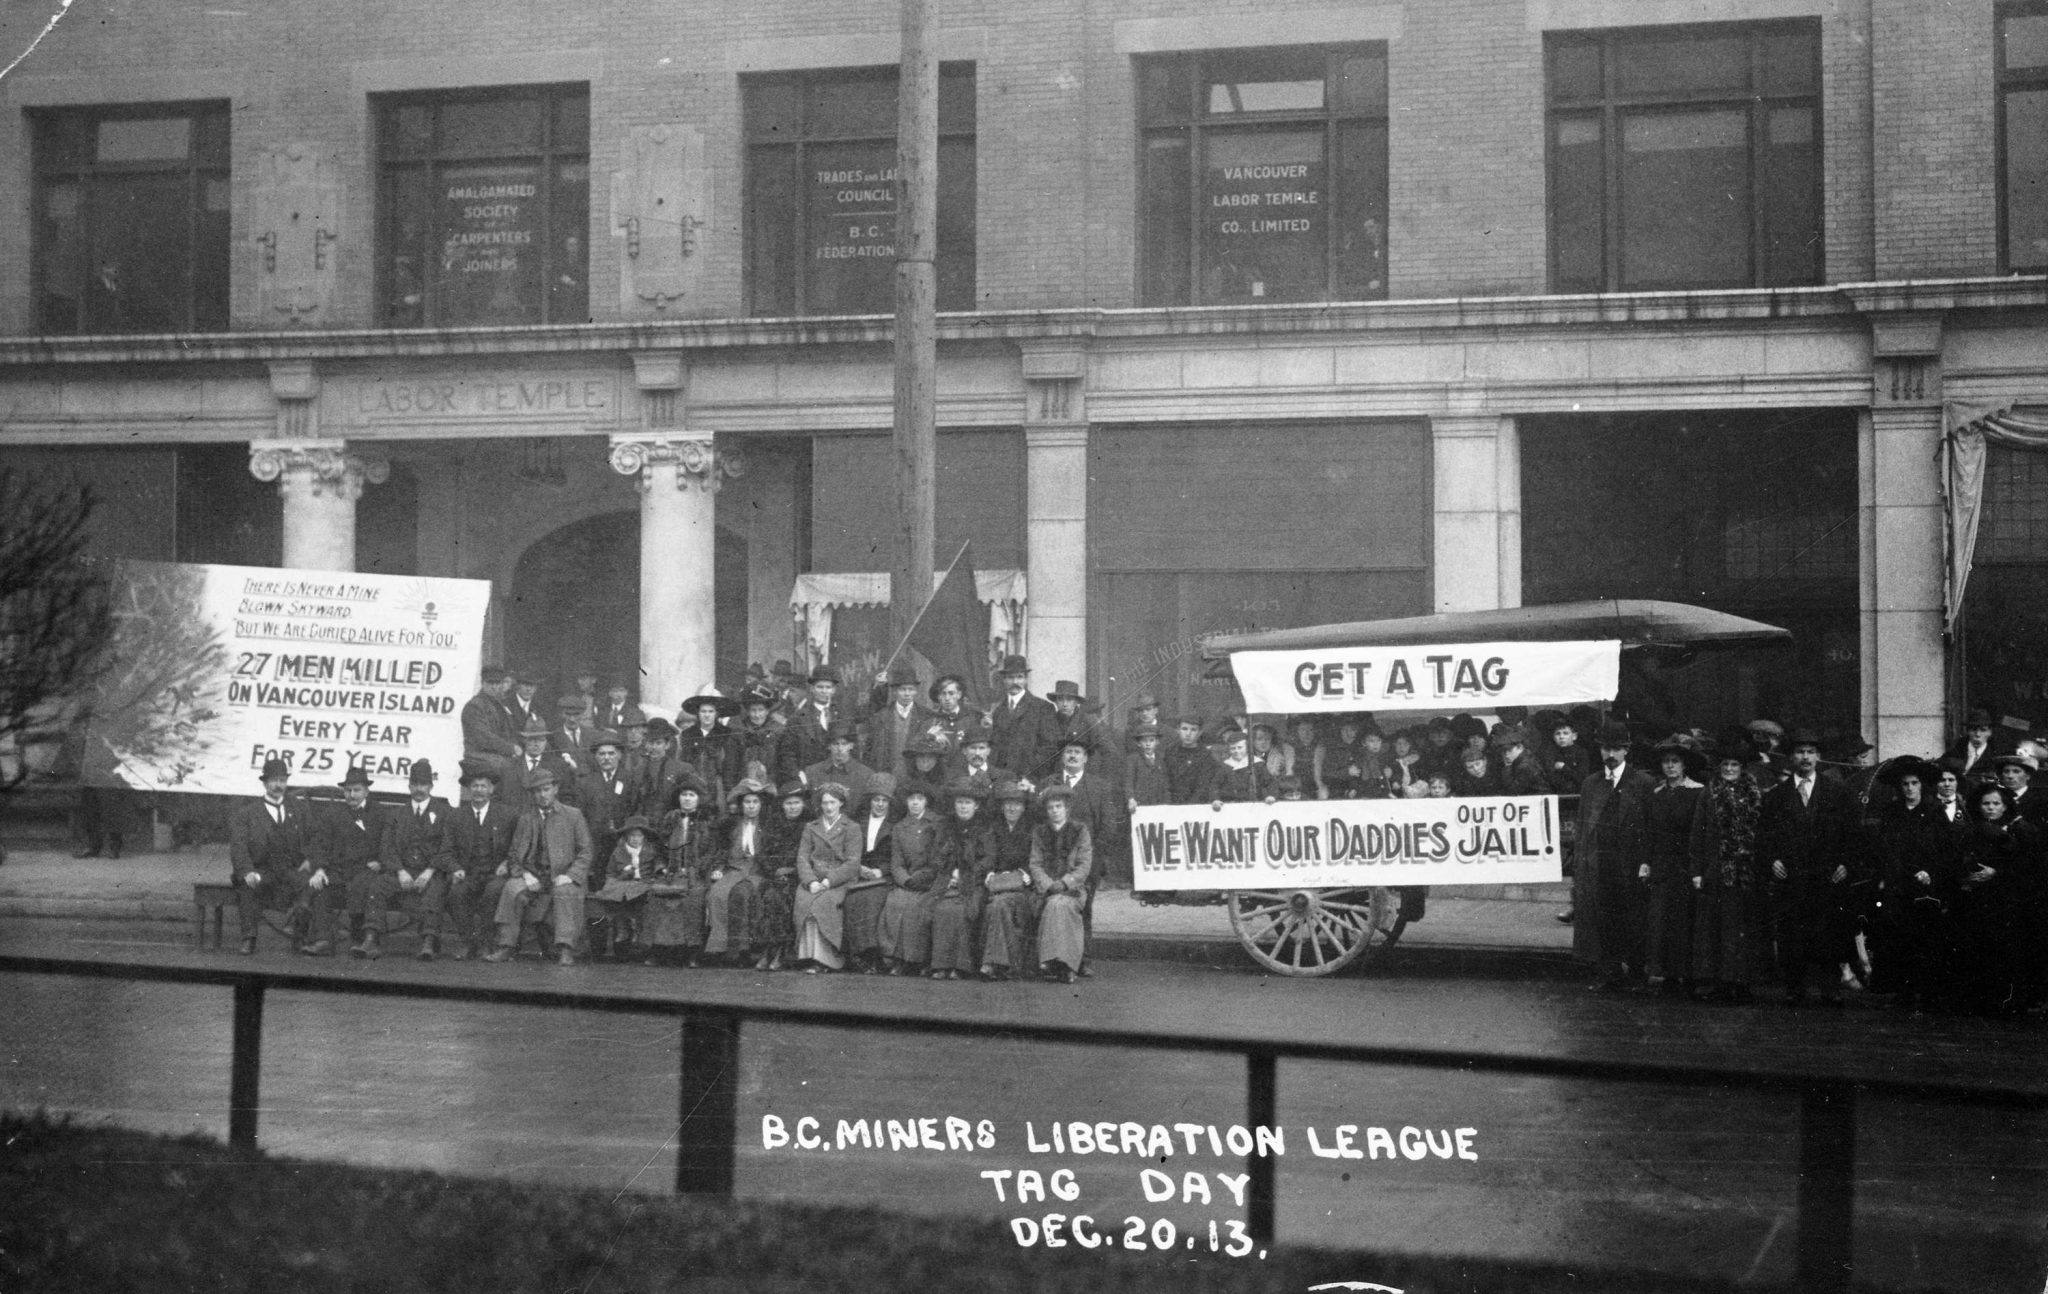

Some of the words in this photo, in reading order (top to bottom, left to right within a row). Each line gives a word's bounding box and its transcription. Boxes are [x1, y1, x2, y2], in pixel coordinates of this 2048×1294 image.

[817, 170, 863, 183] TRADES
[1224, 165, 1307, 179] VANCOUVER
[448, 184, 535, 199] AMALGAMATED
[837, 189, 894, 202] COUNCIL
[1213, 194, 1260, 206] LABOR
[1265, 191, 1318, 205] TEMPLE
[464, 205, 519, 218] SOCIETY
[1252, 219, 1310, 233] LIMITED
[452, 231, 531, 245] CARPENTERS
[462, 258, 518, 272] JOINERS
[358, 384, 457, 412] LABOR
[474, 381, 605, 410] TEMPLE
[244, 578, 280, 593] THERE
[283, 581, 296, 595] IS
[297, 581, 333, 597] NEVER
[337, 584, 345, 597] A
[349, 585, 381, 600] MINE
[238, 598, 283, 614] BLOWN
[263, 621, 280, 636] WE
[284, 623, 307, 638] ARE
[359, 628, 396, 644] ALIVE
[400, 630, 425, 645] FOR
[232, 651, 273, 678] 27
[276, 653, 335, 683] MEN
[340, 657, 443, 689] KILLED
[1295, 661, 1372, 700] GET
[1383, 659, 1414, 699] A
[1424, 654, 1509, 697] TAG
[228, 680, 252, 703] ON
[256, 682, 375, 709] VANCOUVER
[379, 691, 455, 715] ISLAND
[279, 715, 346, 738] EVERY
[354, 720, 412, 744] YEAR
[252, 744, 295, 768] FOR
[302, 747, 334, 771] 25
[346, 750, 438, 780] YEAR
[1457, 804, 1497, 825] OUT
[1502, 802, 1530, 824] OF
[1136, 822, 1181, 871] WE
[1181, 820, 1259, 870] WANT
[1264, 819, 1321, 868] OUR
[1326, 816, 1450, 866] DADDIES
